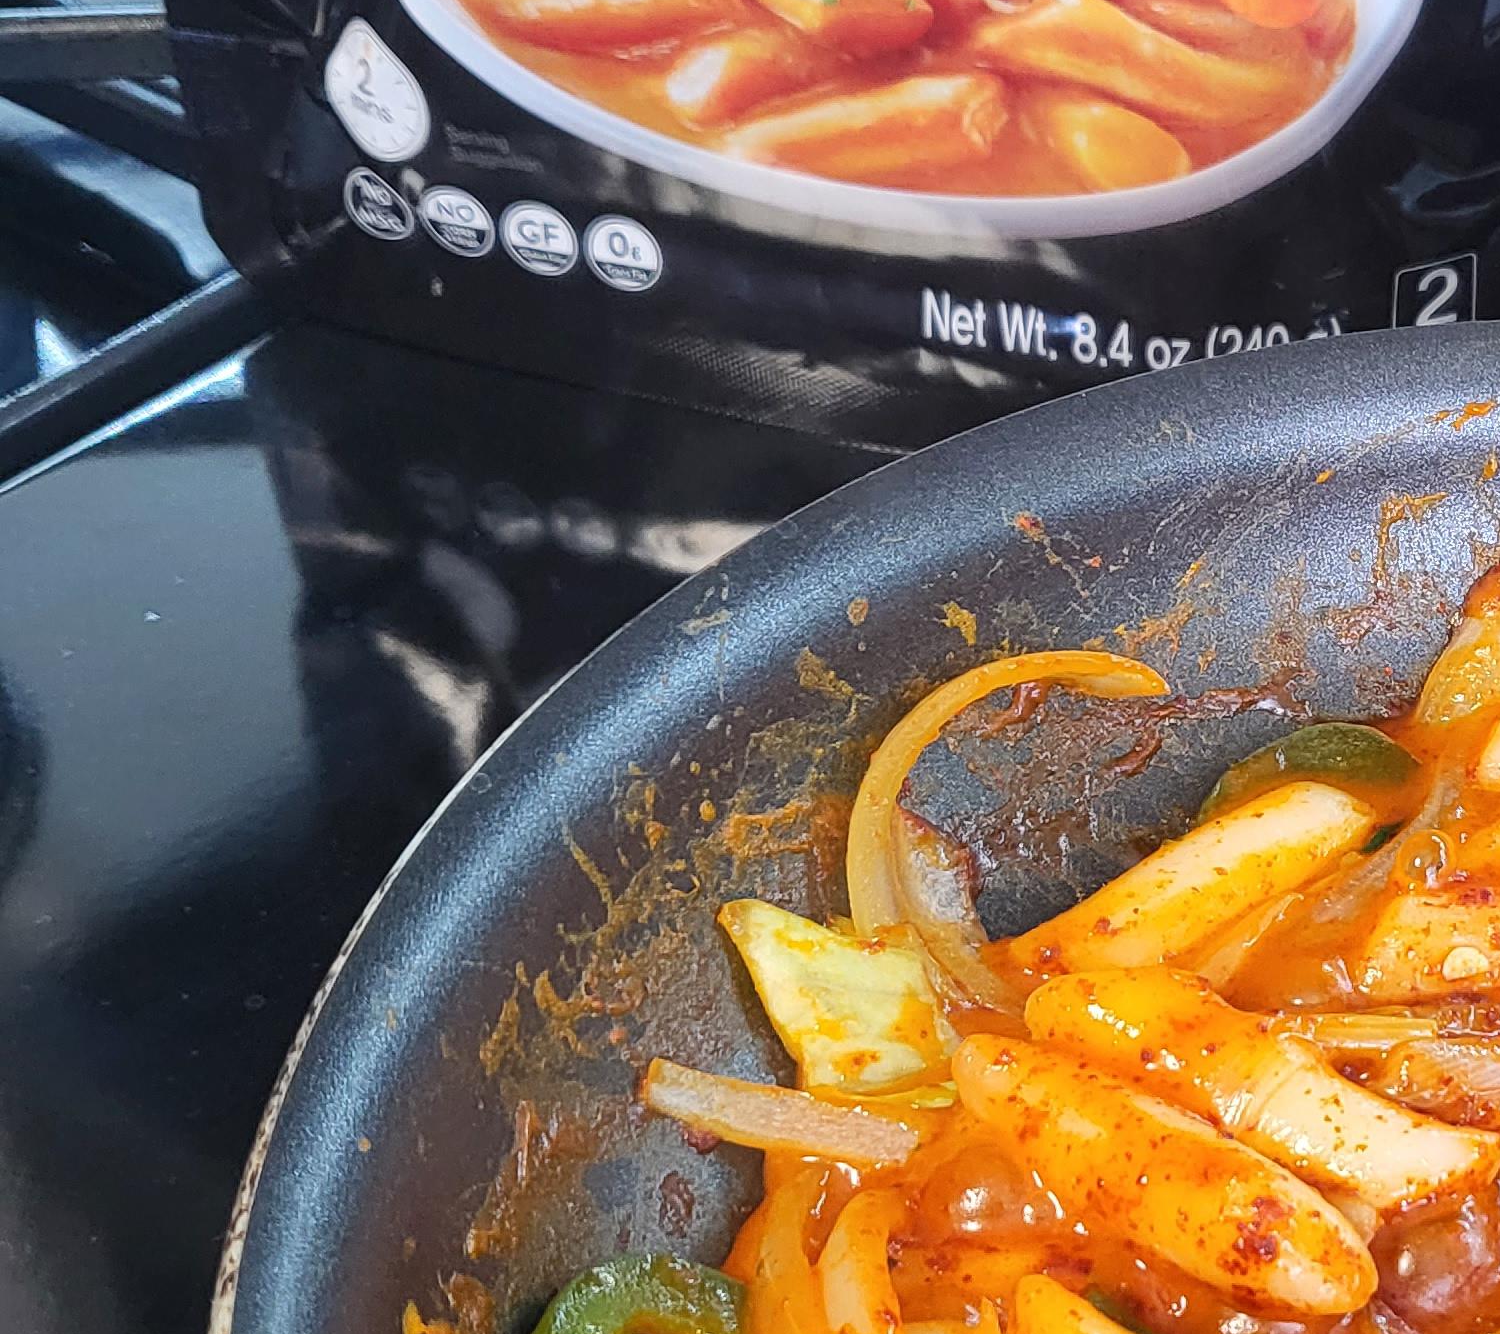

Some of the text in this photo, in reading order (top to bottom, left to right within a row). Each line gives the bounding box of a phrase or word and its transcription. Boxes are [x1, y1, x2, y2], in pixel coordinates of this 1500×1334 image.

[436, 200, 476, 224] NO
[516, 219, 561, 245] GF
[1416, 267, 1459, 327] 2
[921, 286, 987, 348] Net
[1000, 300, 1058, 362] Wt.
[1071, 311, 1133, 368] 8.4
[1145, 335, 1191, 370] oz
